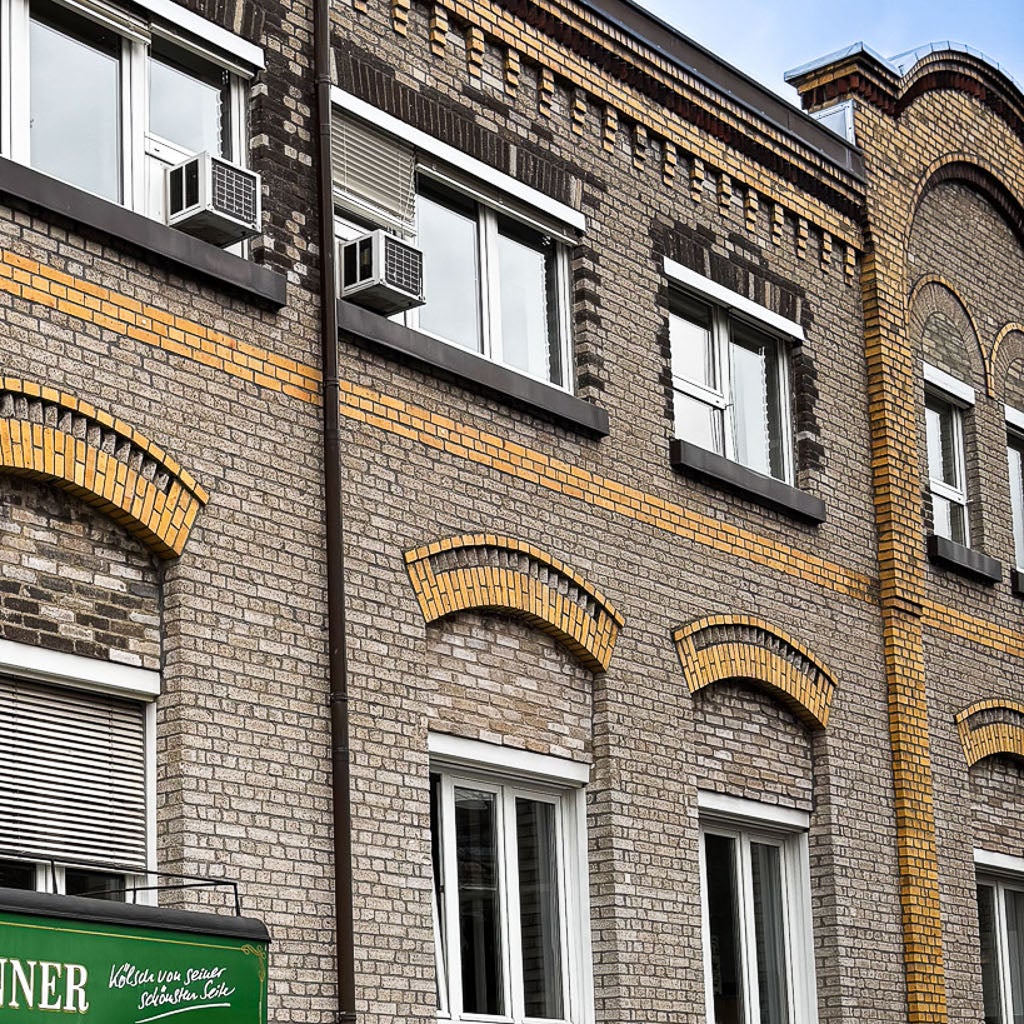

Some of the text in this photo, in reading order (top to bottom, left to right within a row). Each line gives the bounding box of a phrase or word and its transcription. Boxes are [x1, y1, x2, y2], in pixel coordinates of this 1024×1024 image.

[108, 962, 227, 989] Kölsch von seiner
[137, 979, 235, 1010] schönsten Seite
